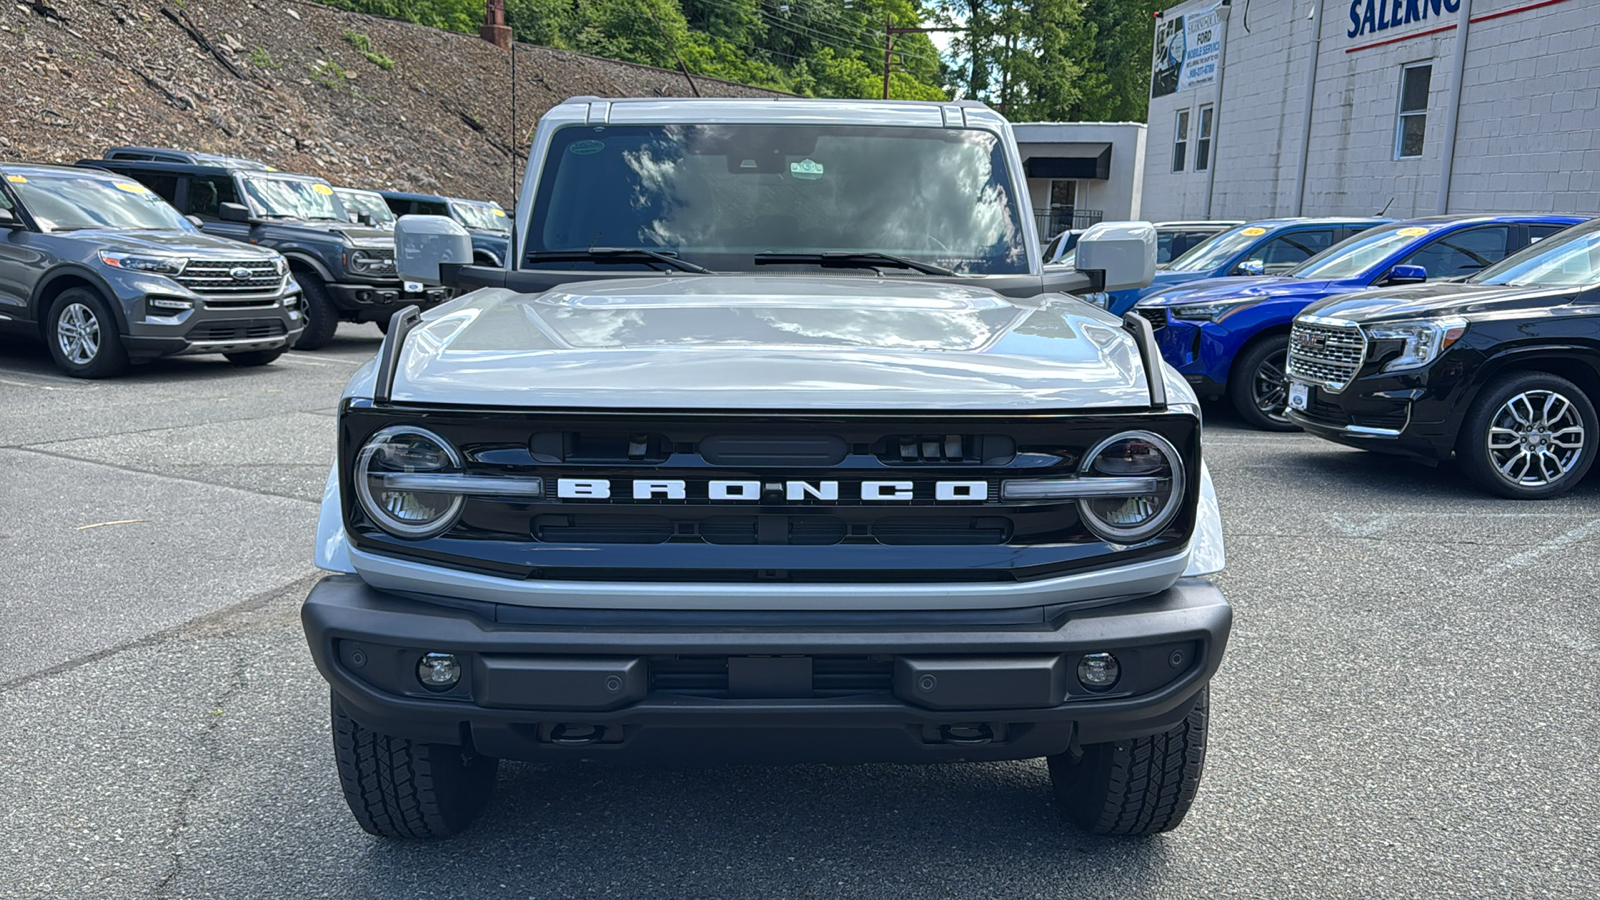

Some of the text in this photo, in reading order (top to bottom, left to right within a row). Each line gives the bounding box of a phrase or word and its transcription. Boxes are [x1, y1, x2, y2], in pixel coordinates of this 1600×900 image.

[1197, 30, 1212, 45] FORD
[1187, 47, 1202, 60] MOBILE
[557, 478, 988, 501] BRONCO
